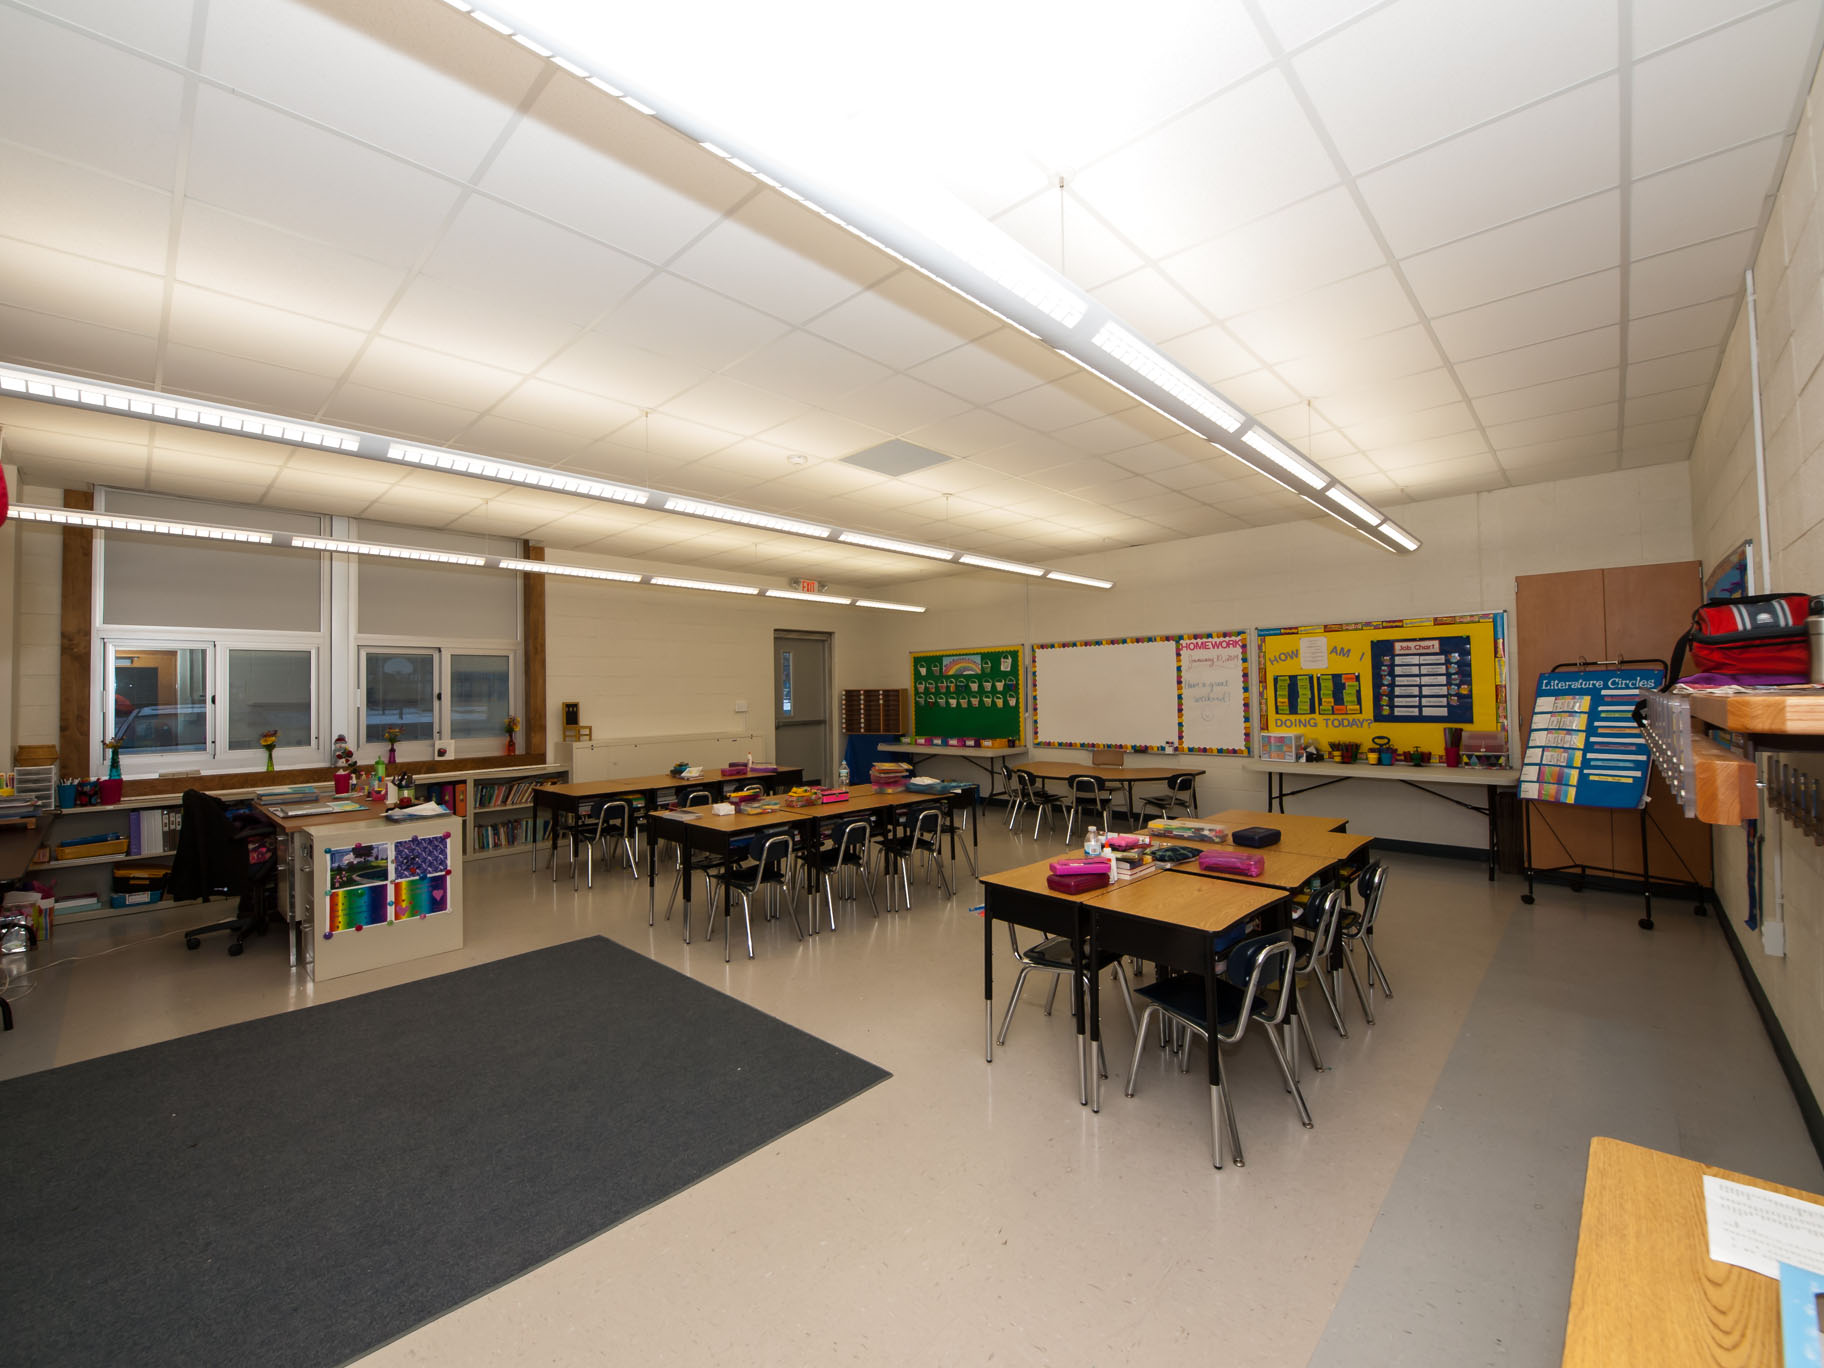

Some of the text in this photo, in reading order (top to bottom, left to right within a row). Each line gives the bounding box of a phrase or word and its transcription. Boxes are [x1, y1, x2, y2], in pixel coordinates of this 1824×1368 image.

[802, 580, 816, 592] EXIT
[1180, 638, 1242, 651] HOMEWORK
[1268, 648, 1299, 666] HOW
[1329, 645, 1352, 659] AM
[1359, 652, 1365, 662] I
[1541, 677, 1655, 690] Literature Circles
[1275, 718, 1374, 729] DOING TODAY?
